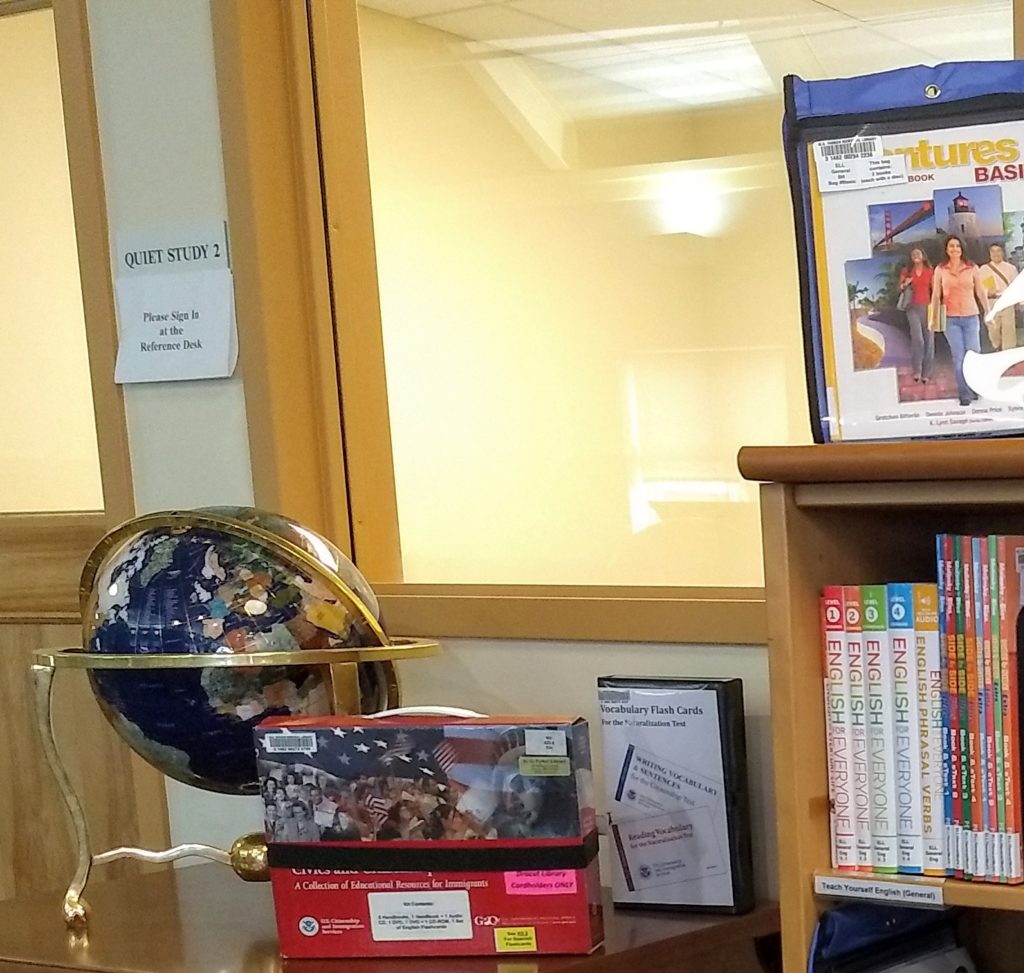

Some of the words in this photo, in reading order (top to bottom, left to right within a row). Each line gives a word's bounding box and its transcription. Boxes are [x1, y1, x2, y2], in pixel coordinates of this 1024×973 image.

[908, 174, 935, 182] BOOK
[124, 249, 163, 269] QUIET
[167, 244, 208, 262] STUDY
[213, 243, 221, 258] 2
[143, 312, 170, 323] Please
[171, 311, 189, 322] Sign
[191, 309, 200, 320] In
[159, 327, 168, 336] at
[169, 326, 184, 336] the
[140, 341, 181, 352] Reference
[183, 339, 203, 350] Desk
[916, 615, 939, 623] AUDIO
[828, 640, 845, 724] ENGLISH
[848, 642, 865, 725] ENGLISH
[867, 640, 884, 725] ENGLISH
[893, 638, 909, 723] ENGLISH
[916, 636, 928, 703] ENGLISH
[600, 705, 649, 716] Vocabulary
[651, 706, 674, 715] Flash
[677, 706, 703, 715] Cards
[930, 670, 943, 729] ENGLISH
[635, 755, 667, 776] WRITING
[919, 708, 930, 779] PHRASAL
[833, 736, 851, 829] EVERYONE
[852, 738, 870, 831] EVERYONE
[871, 737, 889, 831] EVERYONE
[896, 736, 913, 830] EVERYONE
[921, 785, 933, 834] VERBS
[294, 882, 301, 890] A
[303, 881, 339, 890] Collection
[341, 881, 349, 890] of
[351, 880, 393, 890] Educational
[396, 881, 431, 889] Resources
[432, 880, 443, 889] for
[445, 879, 489, 891] Immigrants
[821, 882, 842, 891] Teach
[844, 884, 873, 893] Yourself
[875, 886, 901, 897] English
[903, 890, 936, 900] (General)
